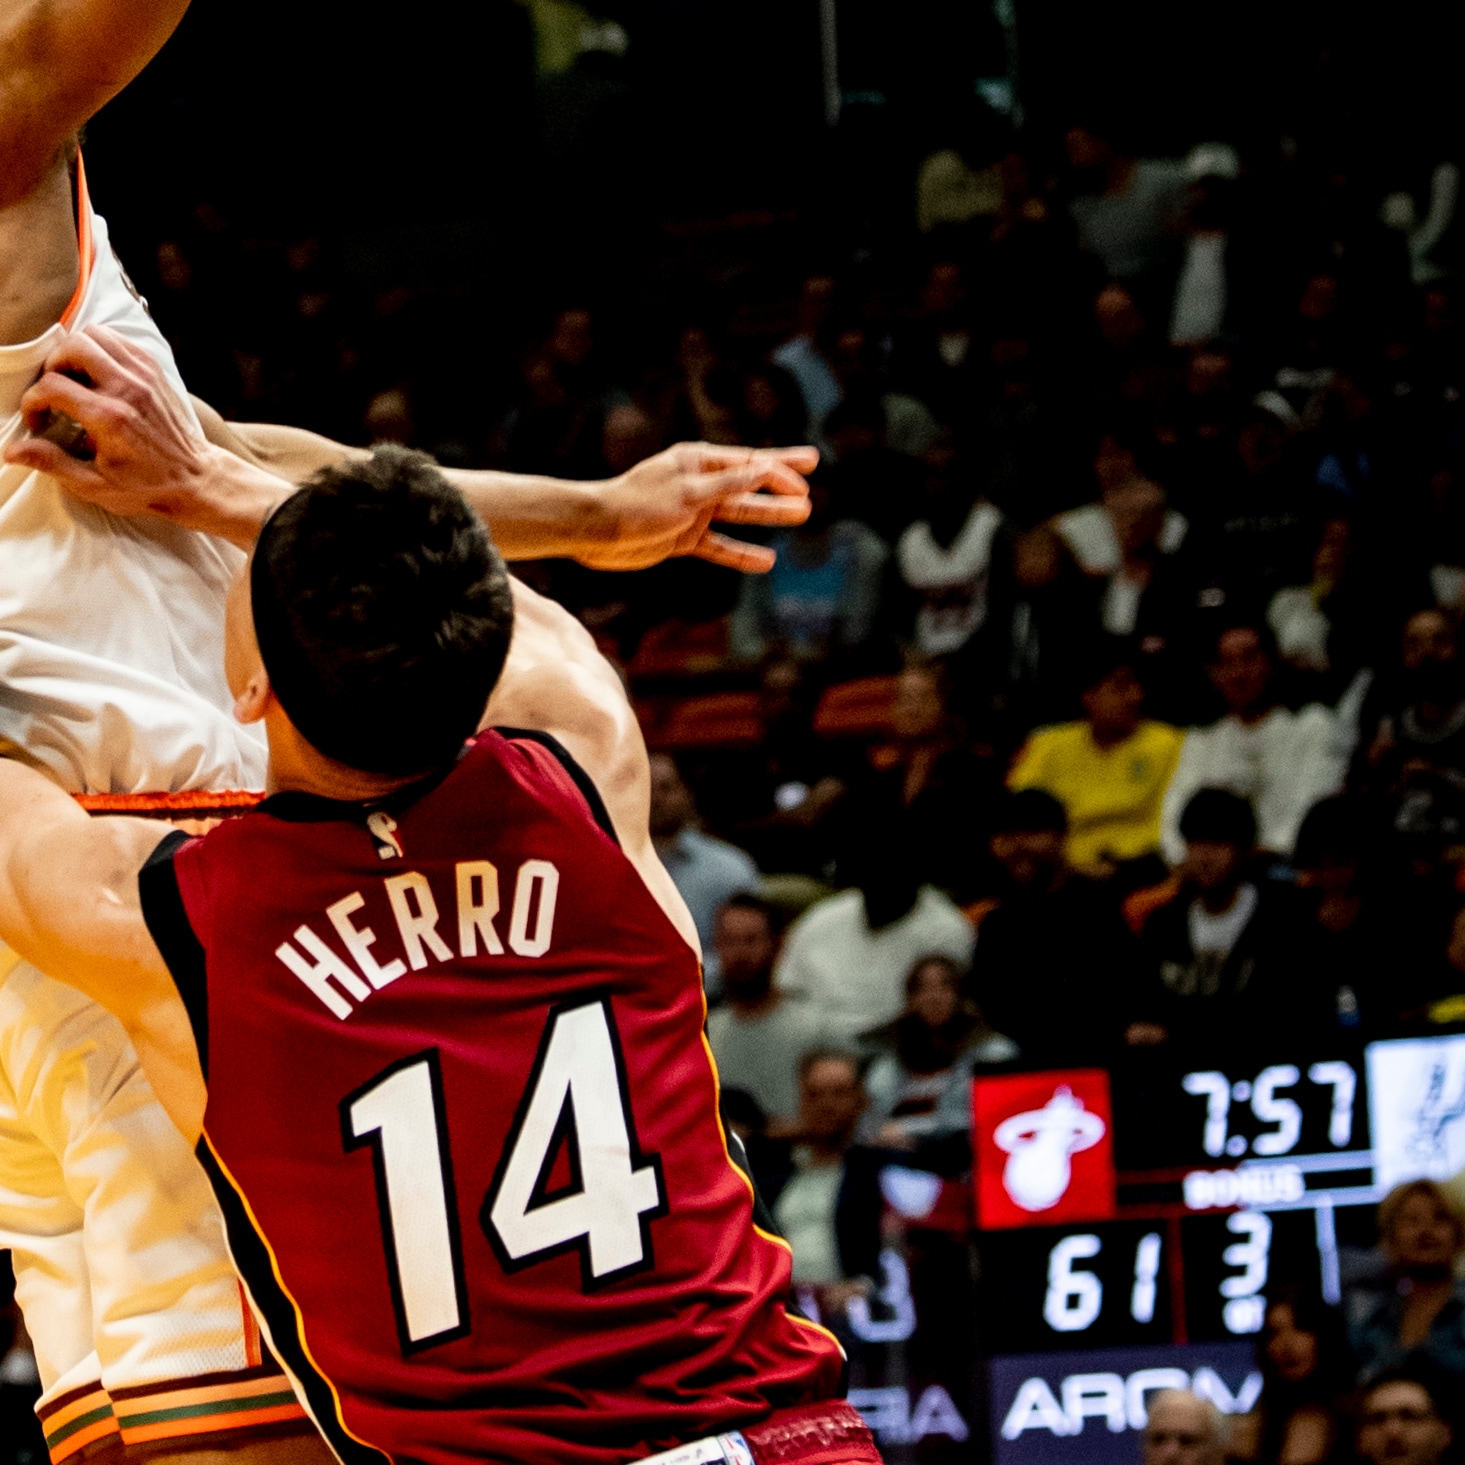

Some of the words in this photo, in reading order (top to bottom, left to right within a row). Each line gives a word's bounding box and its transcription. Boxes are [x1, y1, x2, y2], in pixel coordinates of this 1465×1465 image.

[275, 859, 560, 1021] HERRO
[342, 992, 667, 1354] 14
[1183, 1061, 1356, 1157] 7:57
[1043, 1233, 1162, 1332] 61
